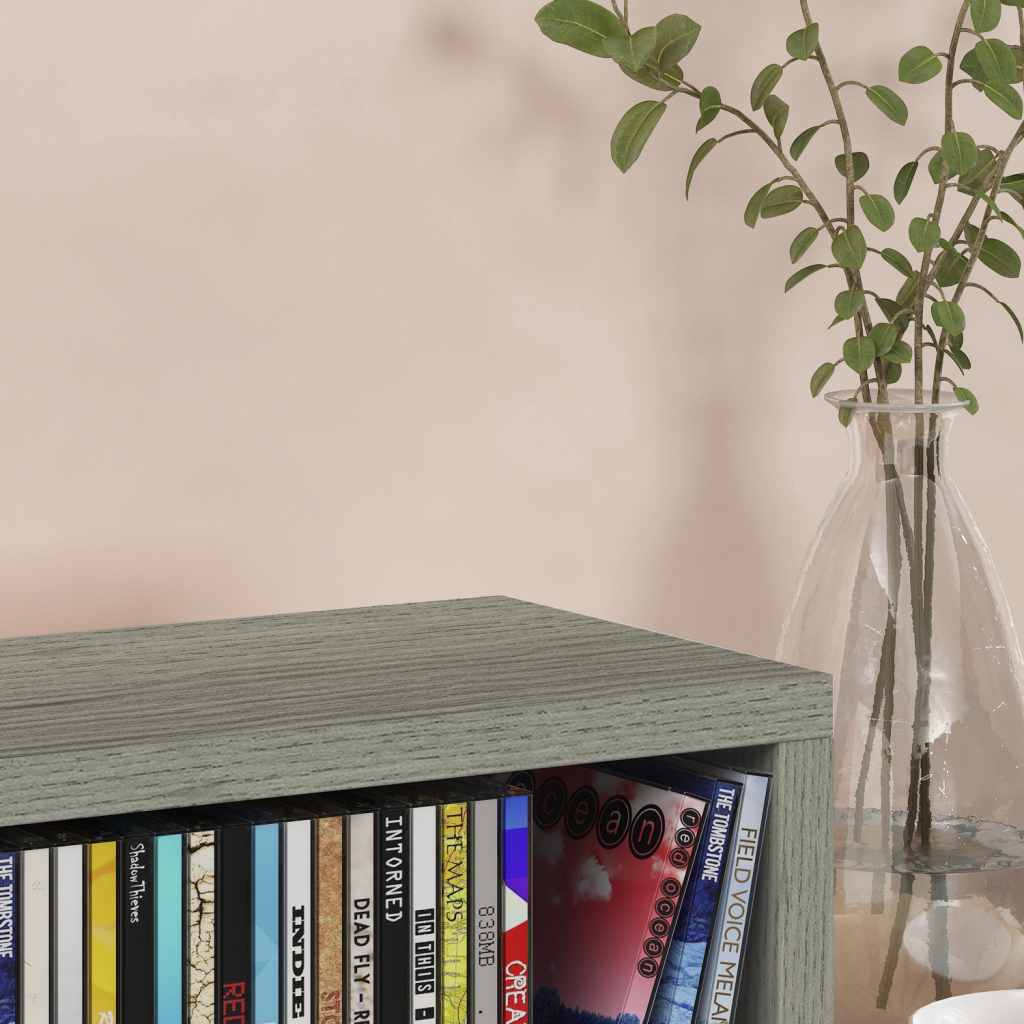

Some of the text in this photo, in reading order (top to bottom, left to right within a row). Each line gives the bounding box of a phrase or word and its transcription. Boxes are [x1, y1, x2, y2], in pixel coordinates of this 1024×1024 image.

[446, 806, 463, 855] THE
[701, 788, 736, 883] THE TOMBSTONE
[733, 827, 758, 884] FIELD
[385, 815, 403, 923] INTORNED
[446, 860, 464, 922] MAPS
[637, 807, 702, 979] red ocean
[354, 898, 370, 947] DEAD
[415, 908, 434, 936] IN
[478, 906, 495, 967] 838MB
[722, 889, 748, 954] VOICE
[292, 905, 305, 1019] INDIE
[354, 954, 370, 984] FLY
[415, 941, 434, 995] THIS
